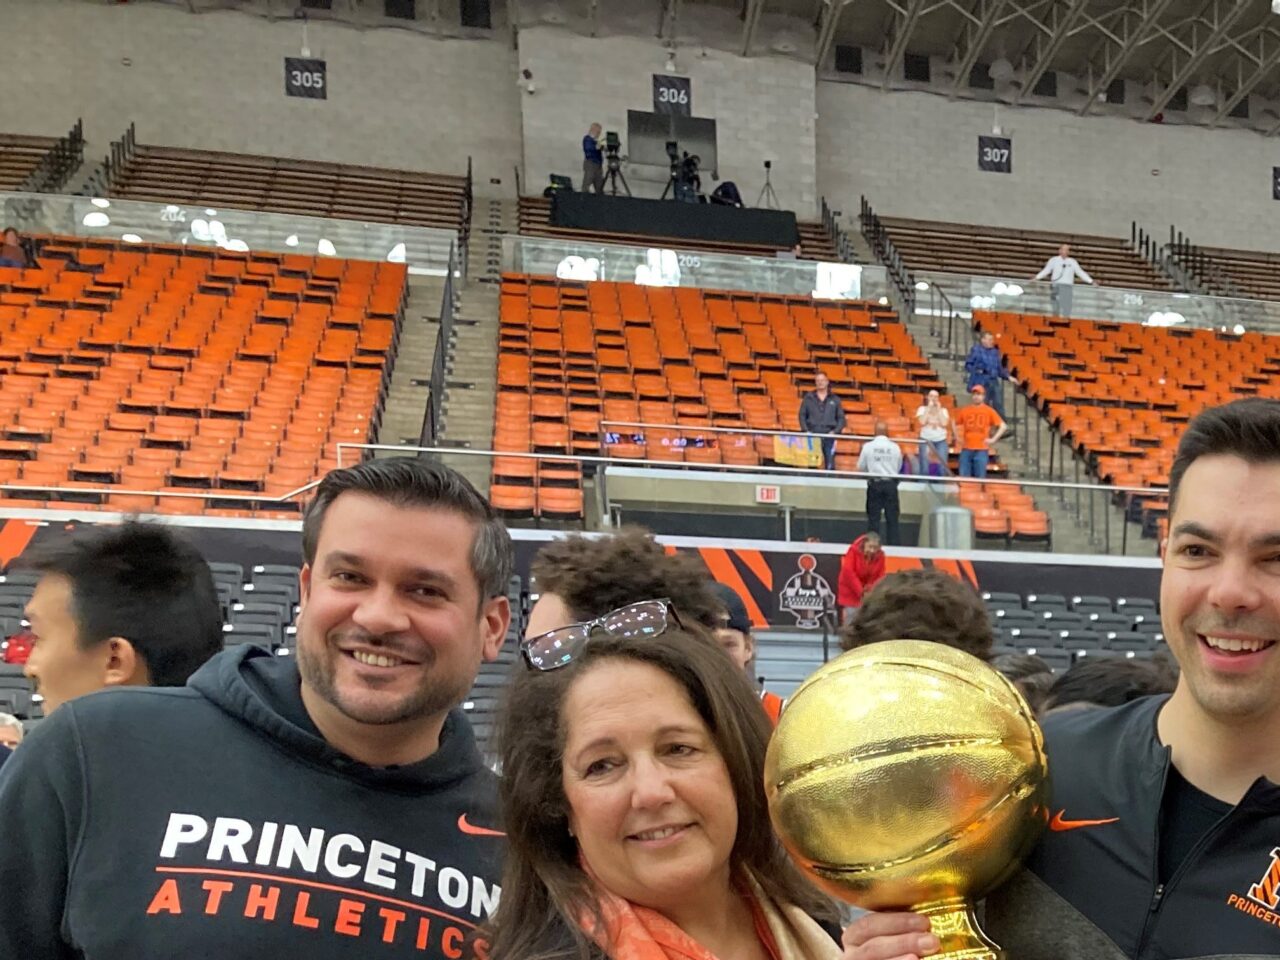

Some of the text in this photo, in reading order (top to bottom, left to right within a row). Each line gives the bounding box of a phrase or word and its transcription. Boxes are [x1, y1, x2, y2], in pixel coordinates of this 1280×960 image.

[291, 70, 323, 88] 305
[658, 87, 688, 104] 306
[983, 147, 1009, 163] 307
[678, 255, 701, 268] 205
[159, 812, 503, 920] PRINCETON
